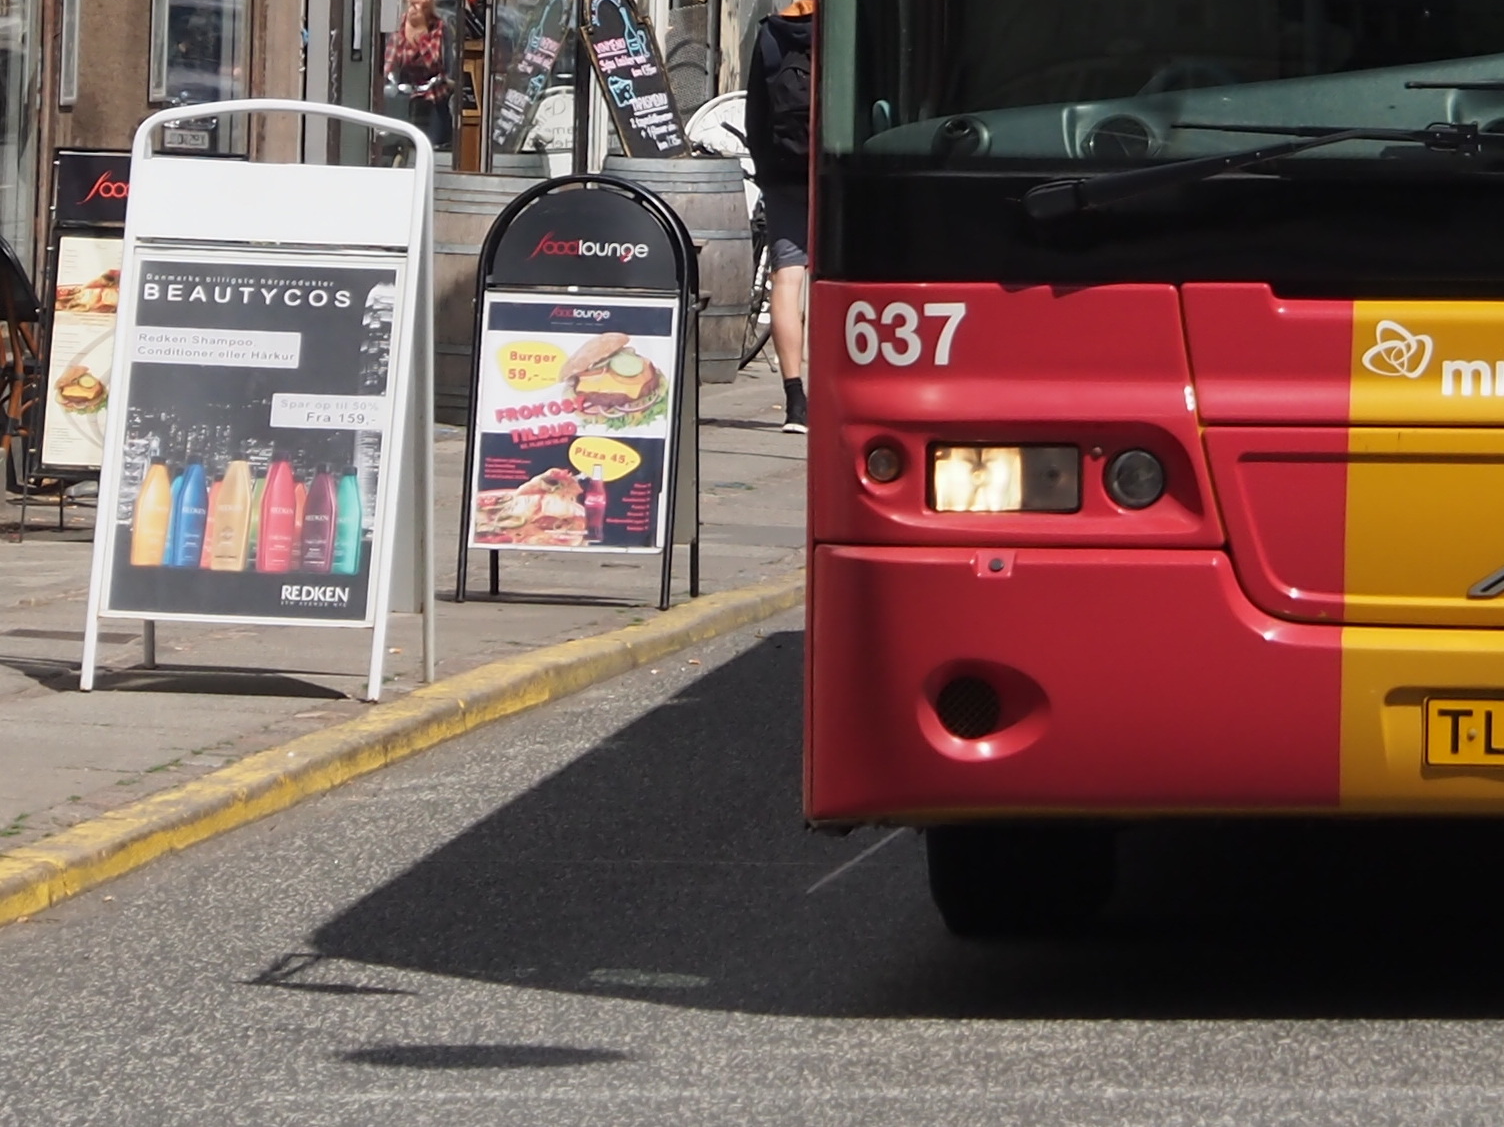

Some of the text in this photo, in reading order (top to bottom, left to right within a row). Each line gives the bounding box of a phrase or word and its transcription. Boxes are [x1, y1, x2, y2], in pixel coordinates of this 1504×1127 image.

[526, 231, 649, 262] foodlounge
[143, 283, 351, 308] BEAUTYCOS
[139, 333, 187, 344] Redken
[844, 301, 966, 367] 637
[137, 346, 214, 358] Conditioner
[218, 350, 246, 359] eller
[510, 351, 557, 364] Burger
[280, 399, 378, 412] Spar op til 50%
[306, 412, 331, 423] Fra
[510, 421, 578, 444] TILBUD
[574, 446, 606, 461] Pizza
[281, 584, 350, 603] REDKEN
